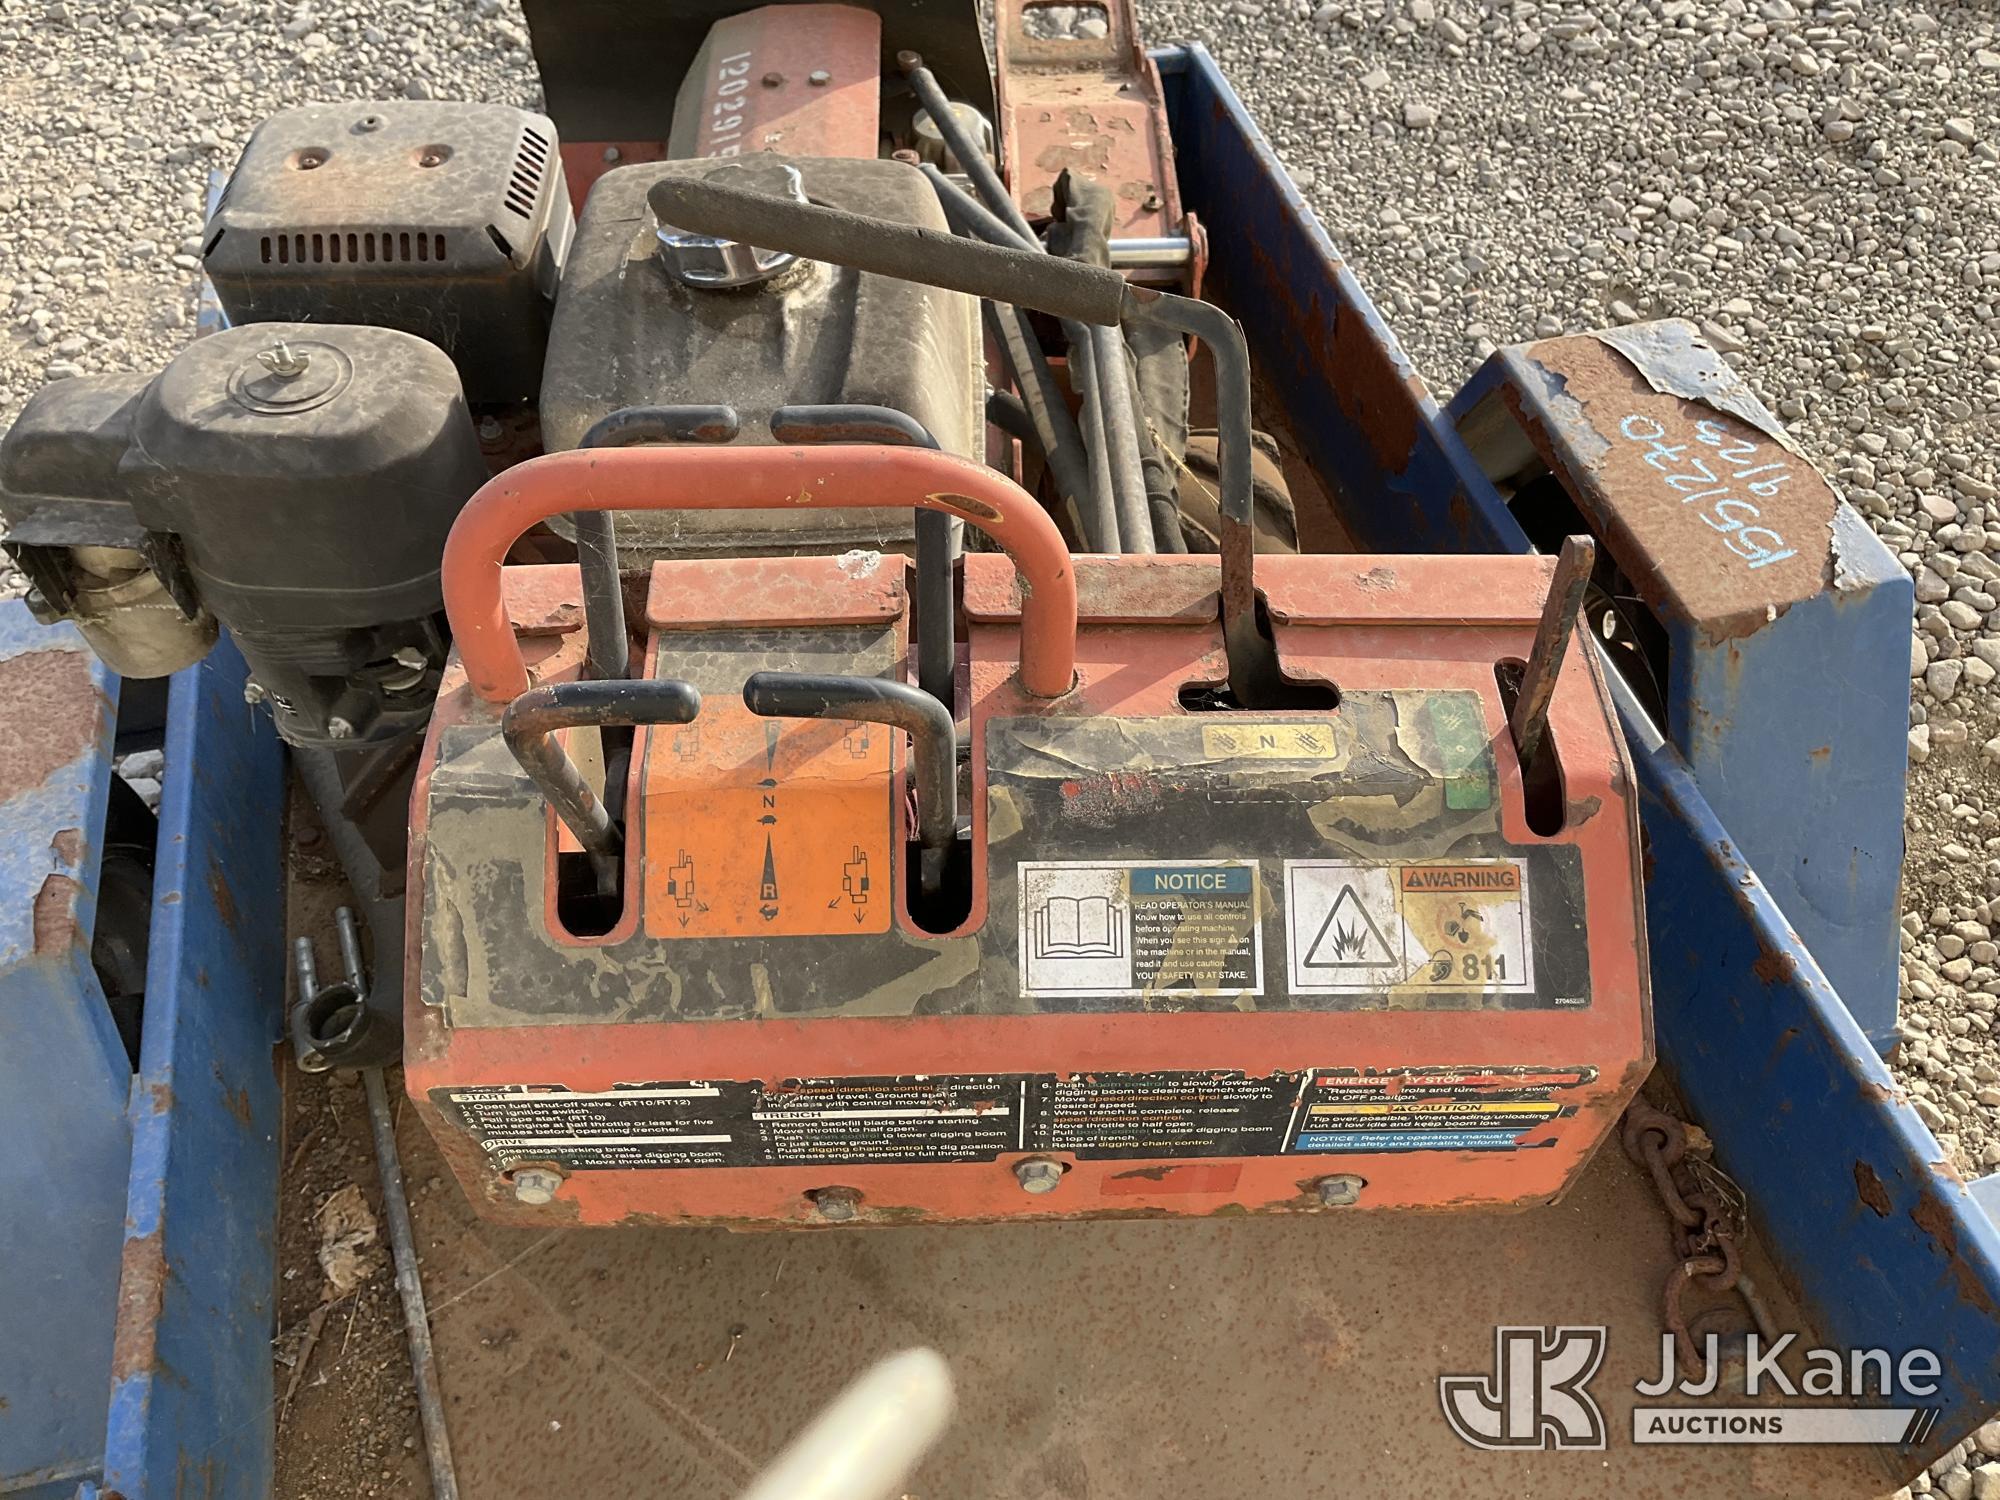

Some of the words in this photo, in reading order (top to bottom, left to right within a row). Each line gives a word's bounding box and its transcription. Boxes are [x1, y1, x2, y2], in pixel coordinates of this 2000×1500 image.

[1259, 735, 1276, 749] N
[763, 795, 774, 808] N
[1155, 874, 1226, 890] NOTICE
[1423, 872, 1514, 887] WARNING
[763, 884, 775, 897] R
[1134, 902, 1157, 910] READ
[1160, 901, 1213, 909] OPERATOR'S
[1215, 901, 1250, 909] MANUAL
[1158, 913, 1175, 921] how
[1136, 925, 1160, 933] before
[1162, 925, 1200, 934] operating
[1209, 937, 1225, 945] sign
[1220, 948, 1251, 956] manual,
[1136, 960, 1154, 968] read
[1462, 953, 1506, 981] 811
[1136, 972, 1160, 980] YOUR
[1219, 971, 1248, 979] STAKE.
[1424, 1076, 1465, 1084] STOP
[800, 1086, 890, 1094] speed/direction
[1088, 1095, 1177, 1103] speed/direction
[575, 1127, 630, 1135] operating
[484, 1139, 527, 1150] DRIVE
[497, 1147, 557, 1157] Disengage
